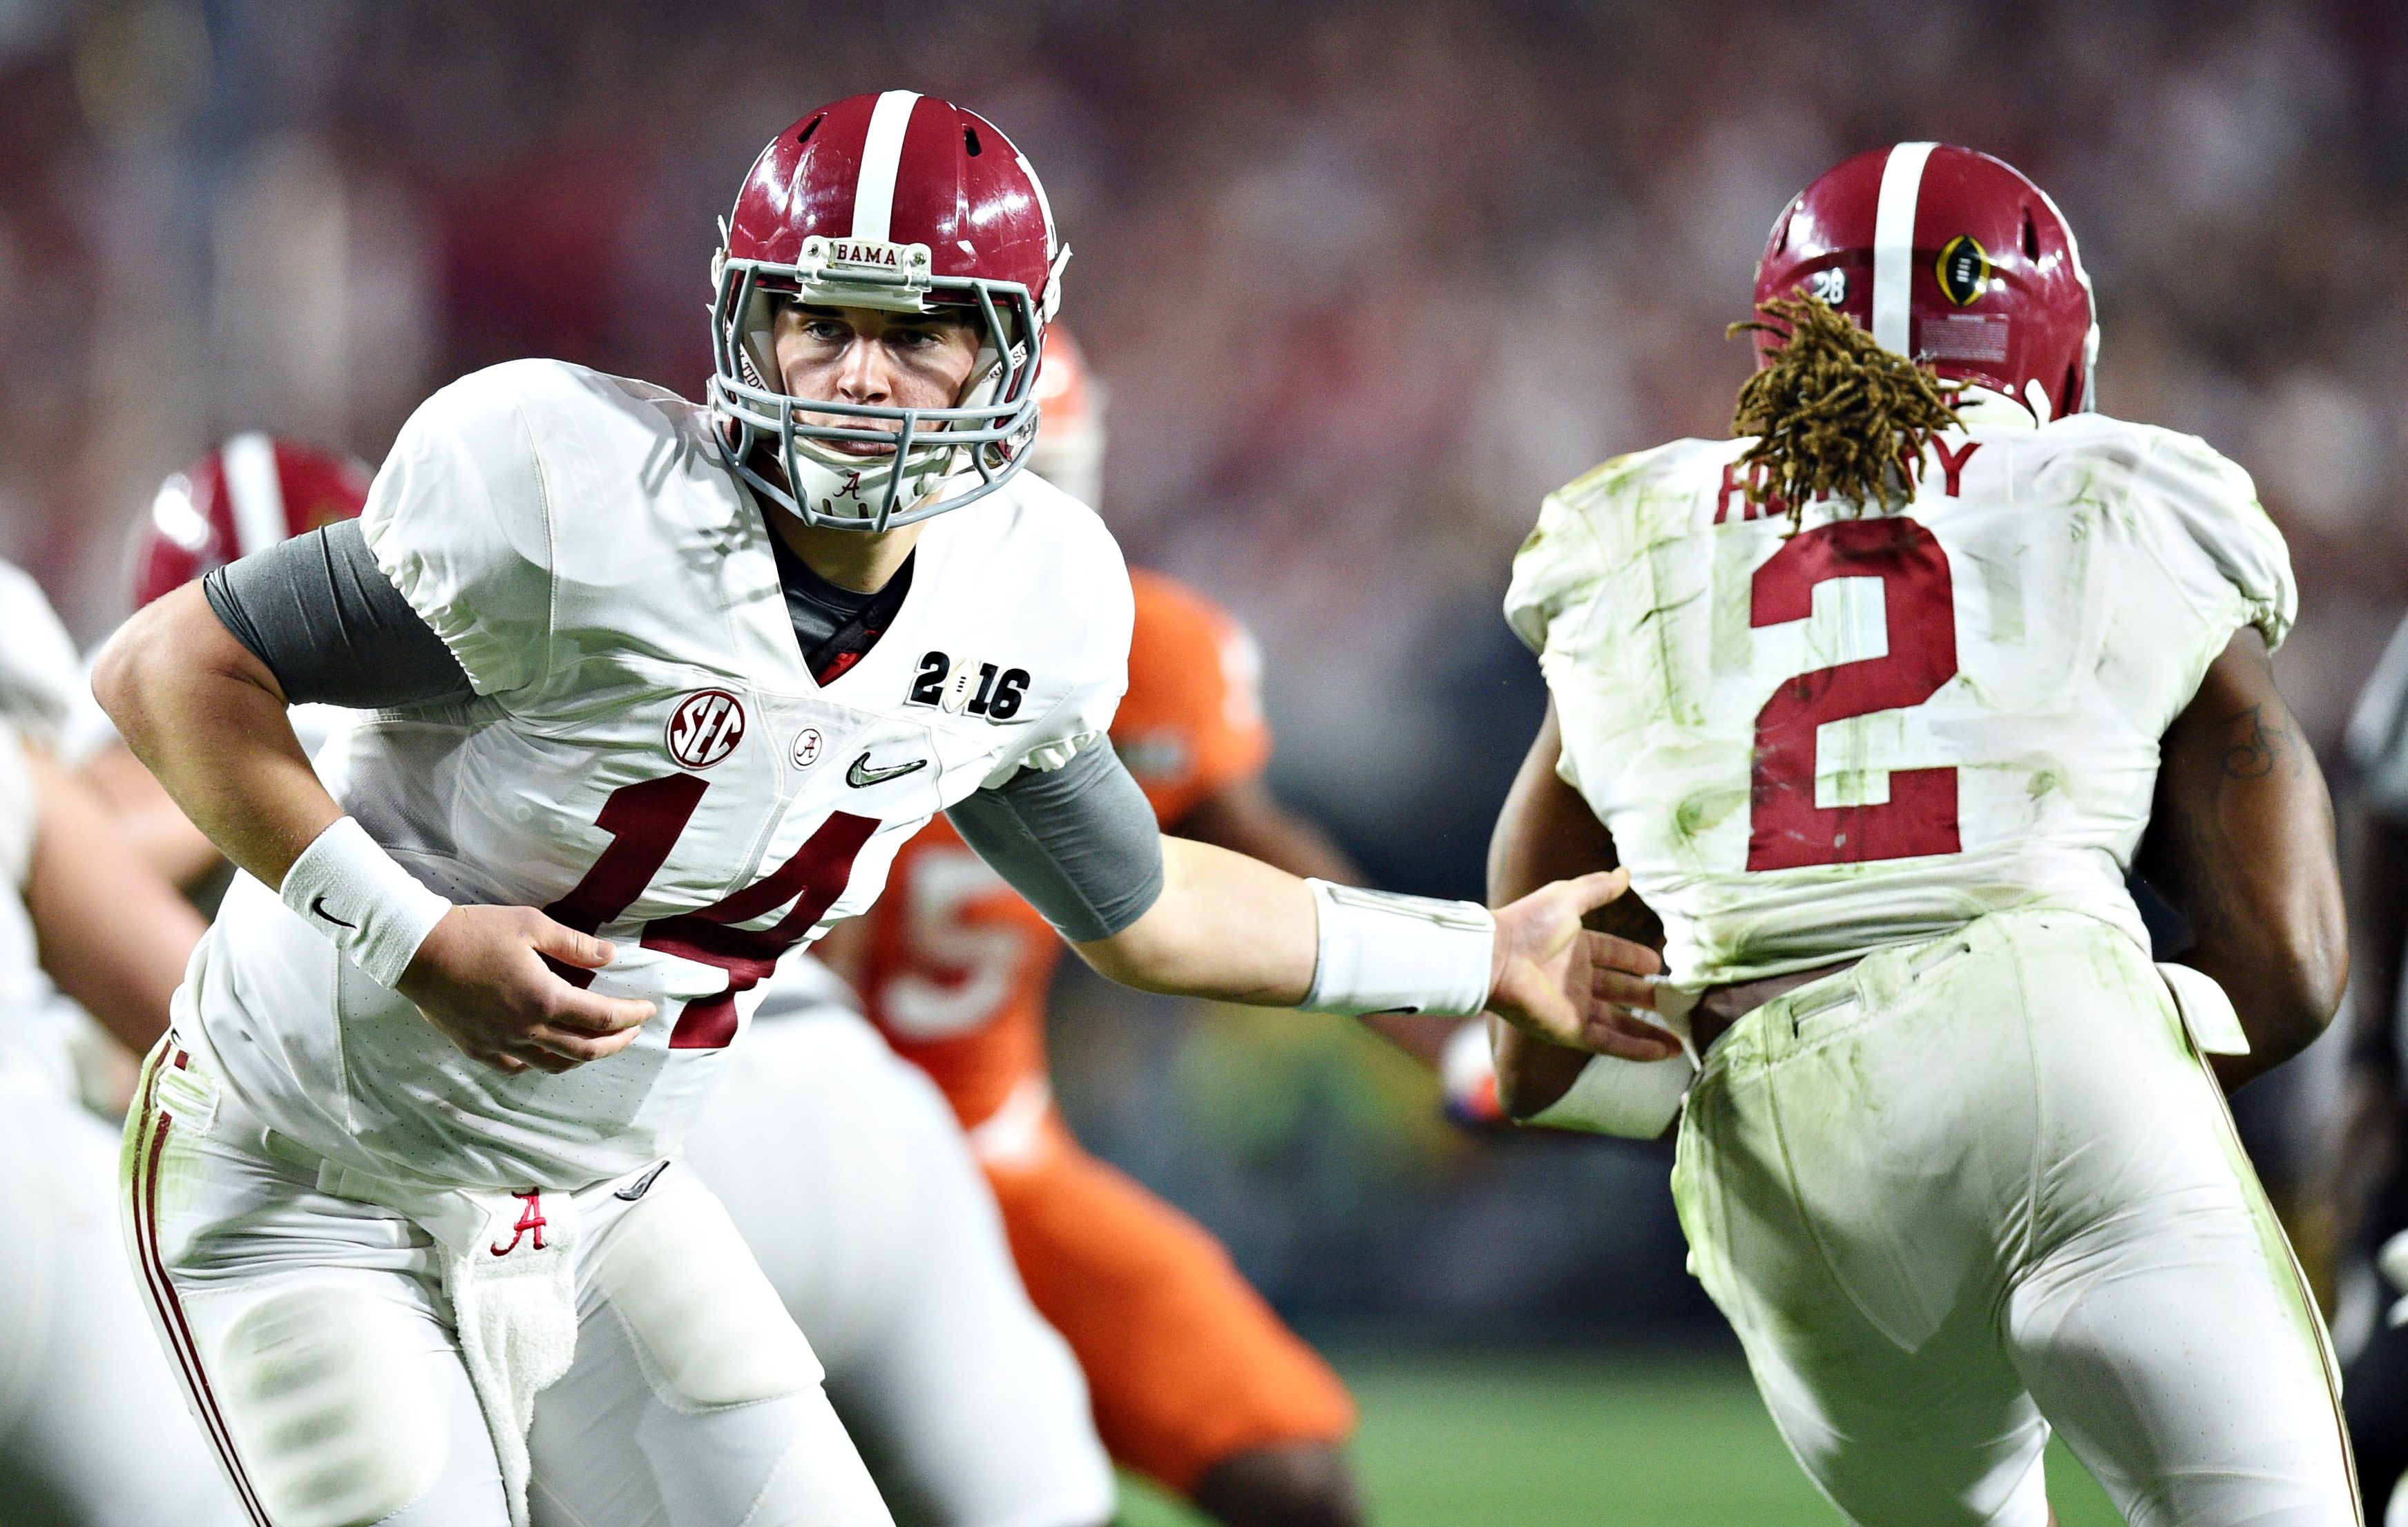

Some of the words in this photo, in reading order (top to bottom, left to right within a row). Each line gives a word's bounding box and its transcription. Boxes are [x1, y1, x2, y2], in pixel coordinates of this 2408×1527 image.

[837, 244, 897, 265] BAMA
[1812, 267, 1846, 304] 28
[832, 472, 861, 500] A
[1746, 516, 1962, 871] 2
[673, 694, 742, 764] SEC
[796, 734, 818, 758] A
[542, 771, 883, 1049] 14
[490, 1186, 548, 1257] A
